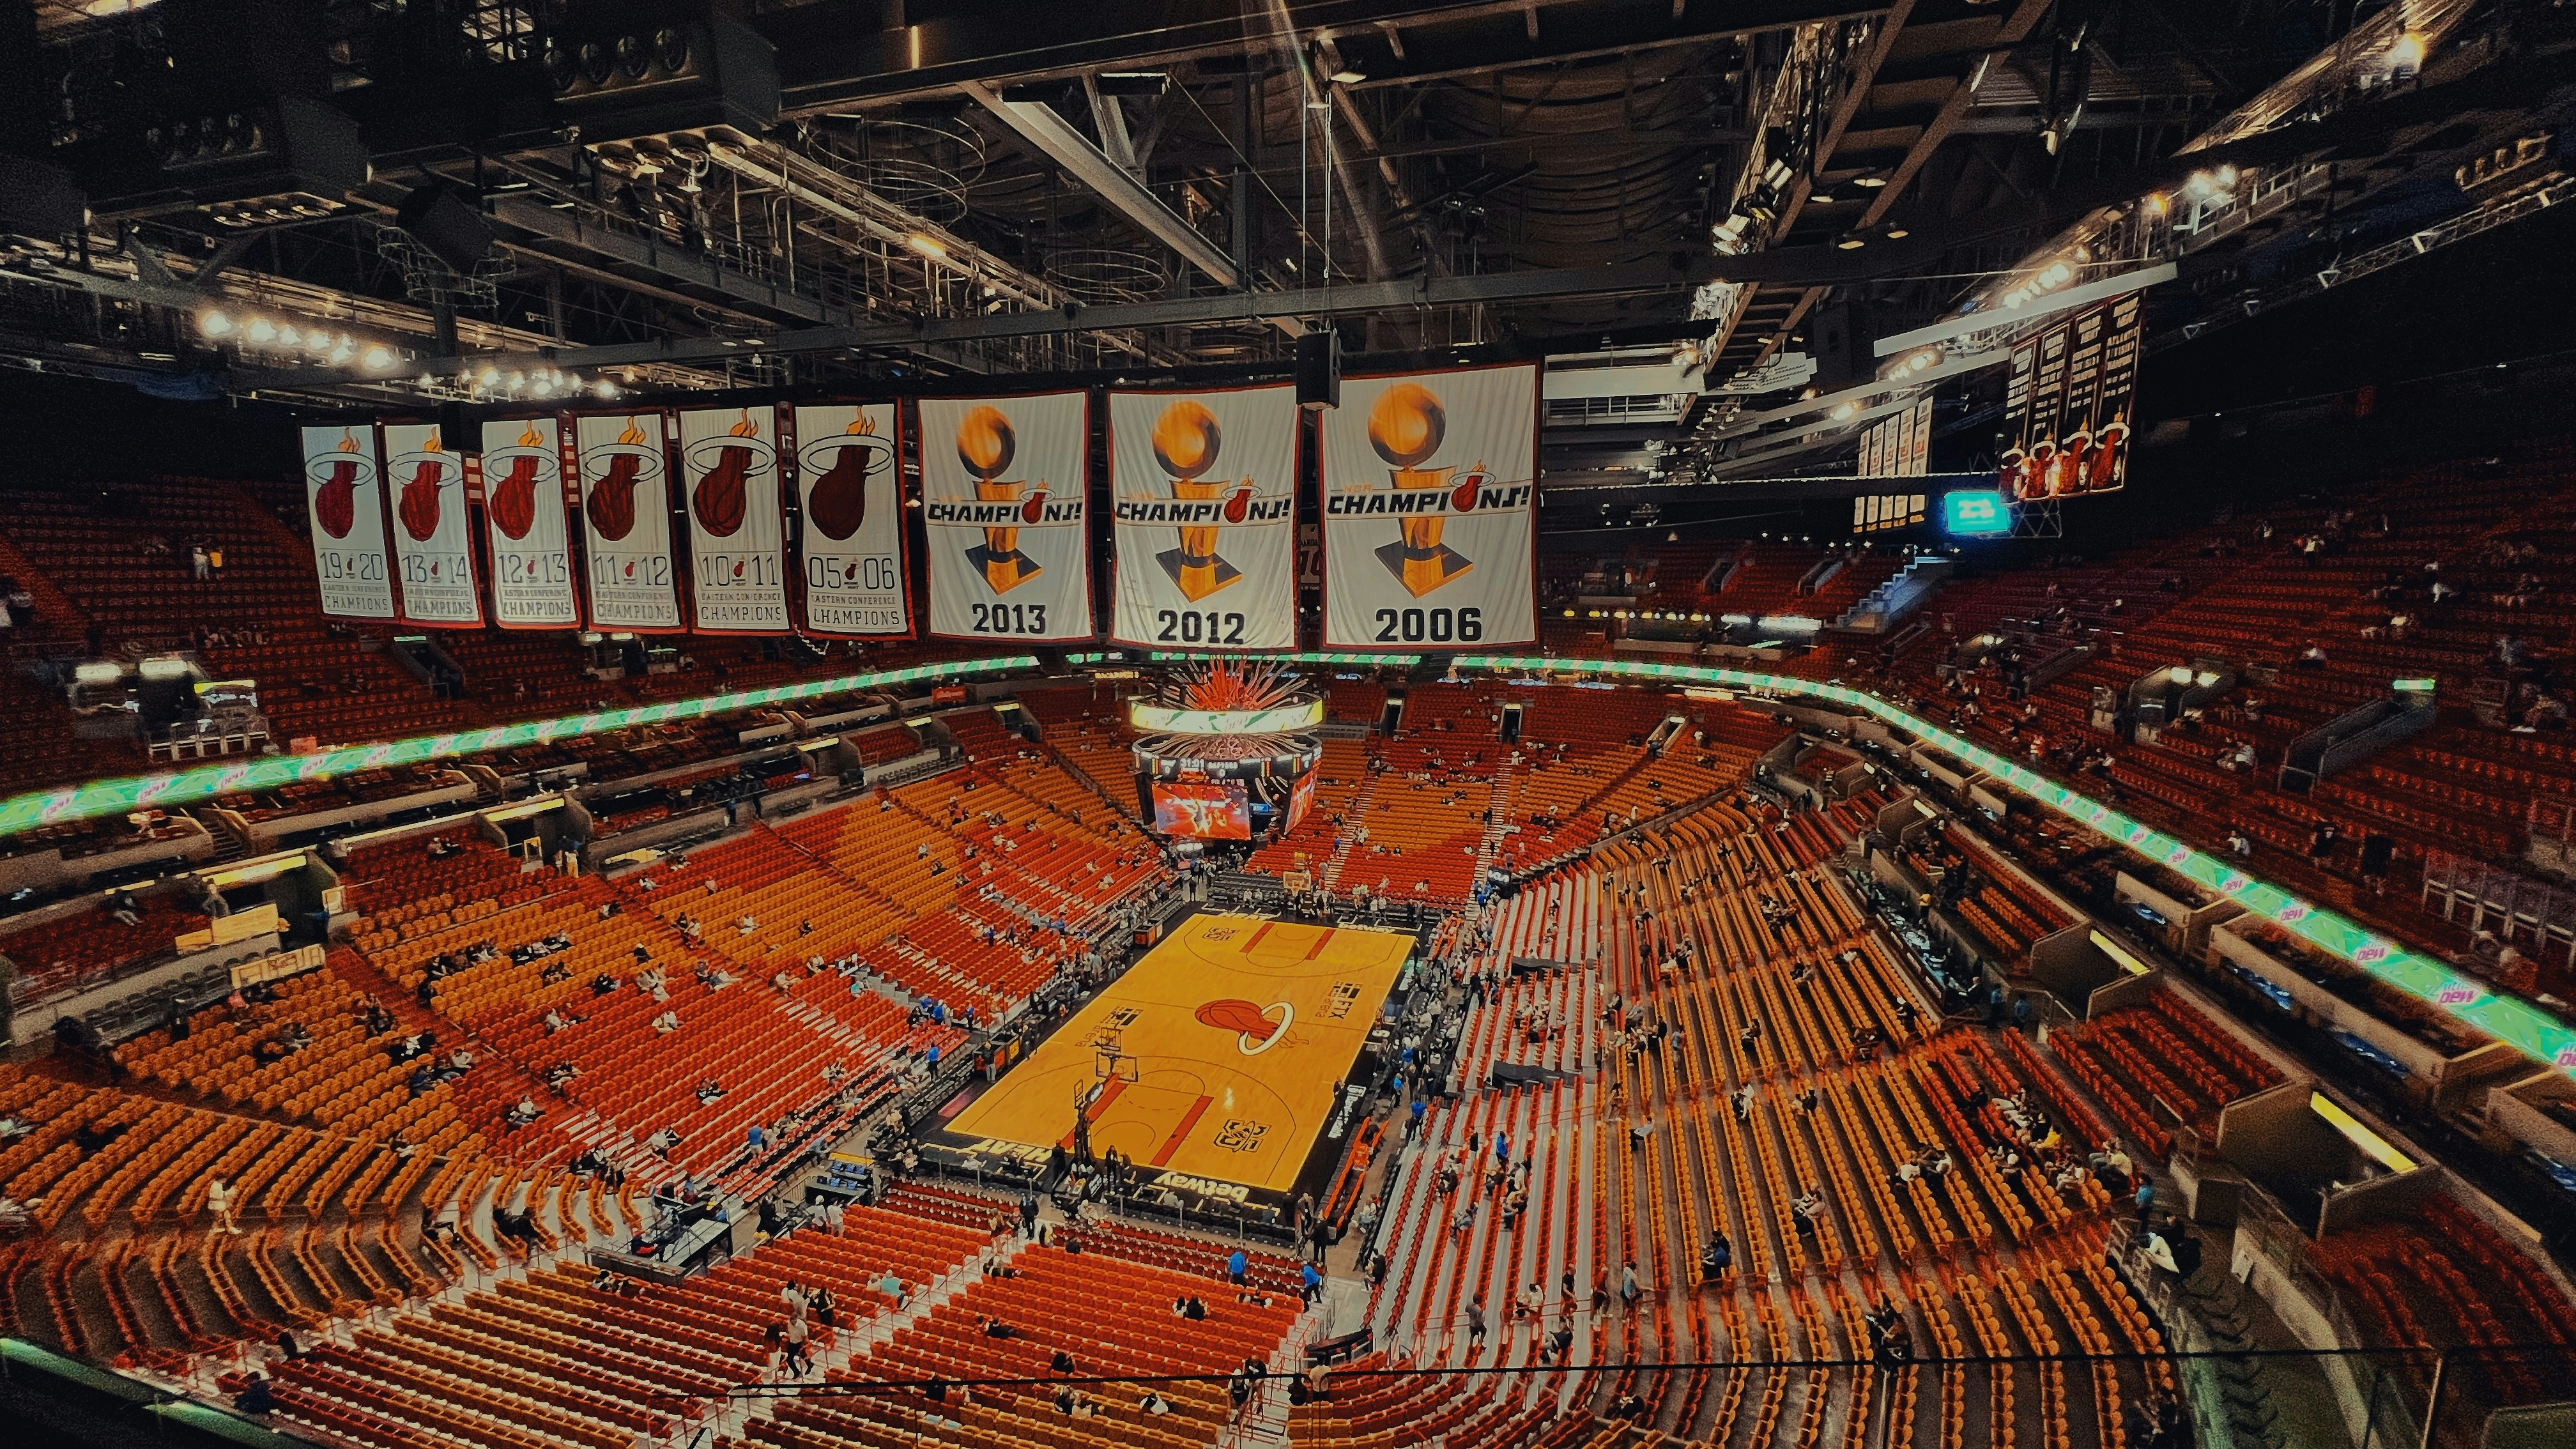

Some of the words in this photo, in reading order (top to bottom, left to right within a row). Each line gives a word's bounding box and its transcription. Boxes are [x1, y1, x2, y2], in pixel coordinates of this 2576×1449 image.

[320, 552, 342, 578] 19
[359, 553, 383, 580] 20
[402, 555, 427, 582] 13
[448, 556, 467, 583] 14
[499, 555, 523, 583] 12
[542, 554, 566, 583] 13
[595, 555, 619, 585] 11
[642, 556, 668, 586] 12
[703, 556, 730, 586] 10
[752, 554, 778, 586] 11
[809, 557, 841, 588] 05
[864, 558, 894, 589] 06
[597, 604, 671, 618] CHAMPIONS
[701, 606, 781, 620] CHAMPIONS
[814, 609, 900, 625] CHAMPIONS
[972, 603, 1046, 634] 2013
[1375, 607, 1482, 642] 2006
[1158, 610, 1245, 645] 2012
[1328, 1000, 1354, 1020] FTX
[967, 1138, 1053, 1163] HEAT
[1153, 1171, 1250, 1202] betway
